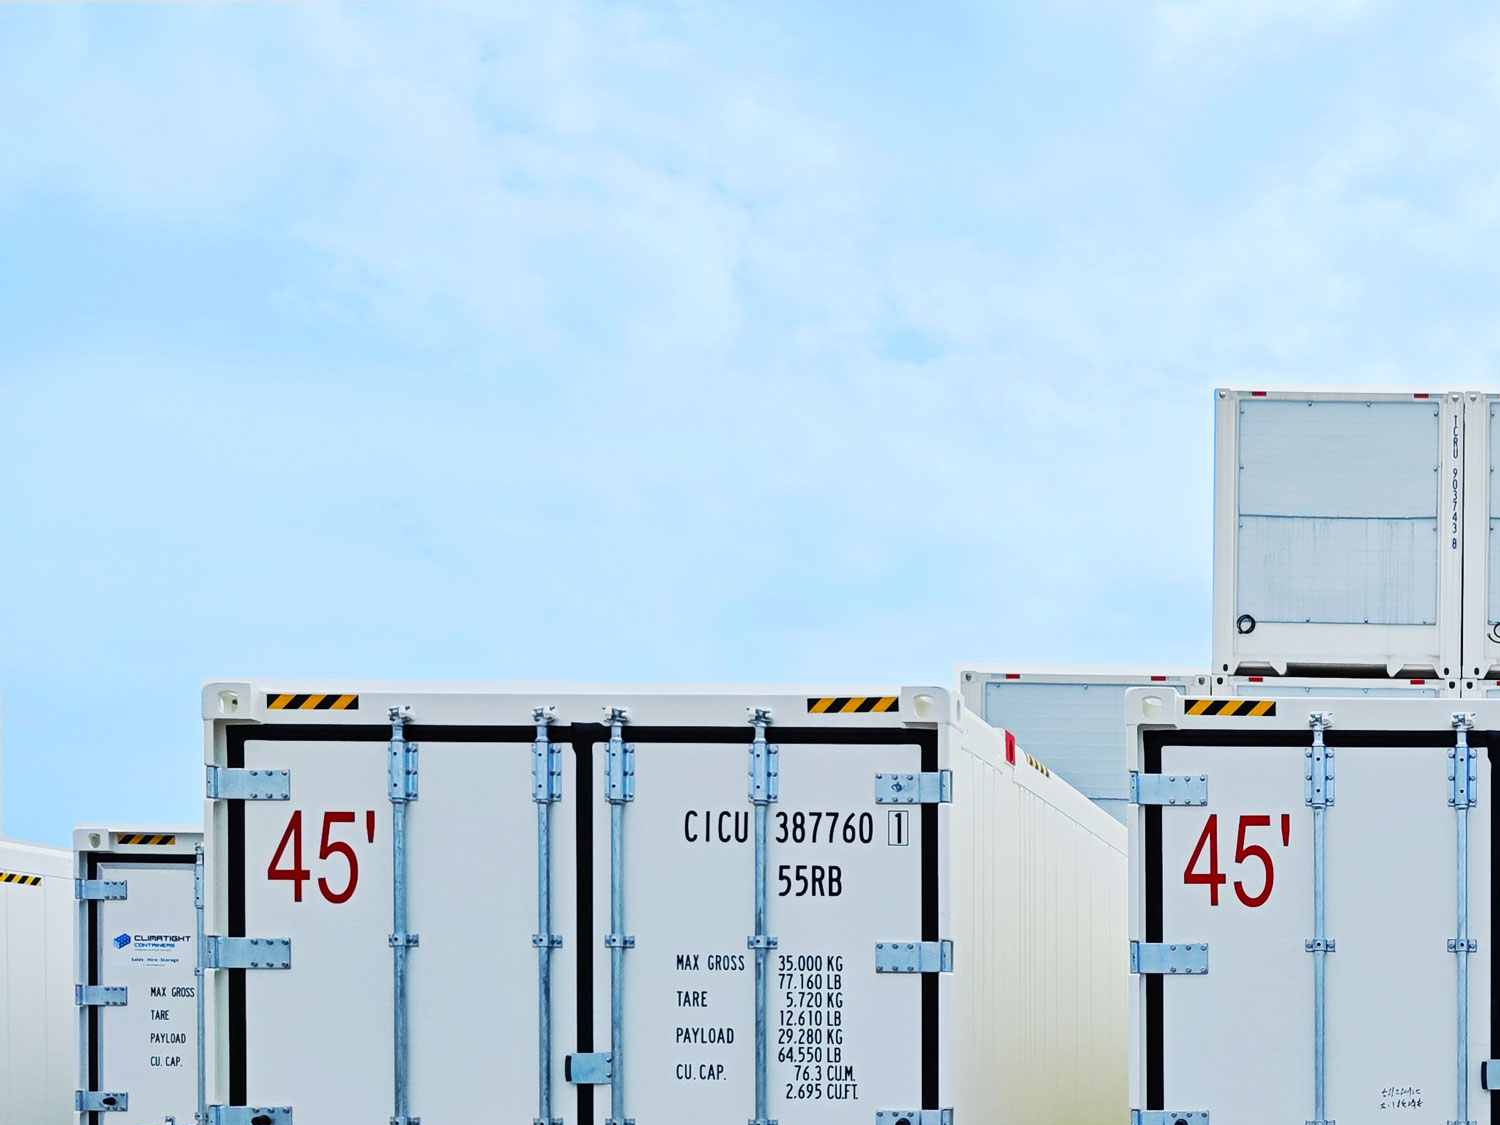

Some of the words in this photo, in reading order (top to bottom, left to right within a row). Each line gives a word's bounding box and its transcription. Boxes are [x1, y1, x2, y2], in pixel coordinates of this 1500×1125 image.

[685, 810, 748, 843] CICU
[776, 811, 873, 844] 387760
[895, 813, 901, 843] 1
[268, 812, 374, 904] 45'
[1184, 815, 1290, 907] 45'
[778, 865, 842, 896] 55RB
[677, 954, 699, 970] MAX
[708, 955, 744, 971] GROSS
[827, 956, 843, 972] KG
[827, 974, 841, 990] LB
[150, 987, 166, 997] MAX
[171, 987, 195, 998] GROSS
[677, 991, 708, 1007] TARE
[827, 992, 843, 1008] KG
[151, 1010, 170, 1020] TARE
[827, 1010, 841, 1026] LB
[150, 1033, 186, 1044] PAYLOAD
[676, 1028, 734, 1044] PAYLOAD
[827, 1029, 842, 1045] KG
[827, 1047, 841, 1063] LB
[794, 1065, 822, 1081] 76.3
